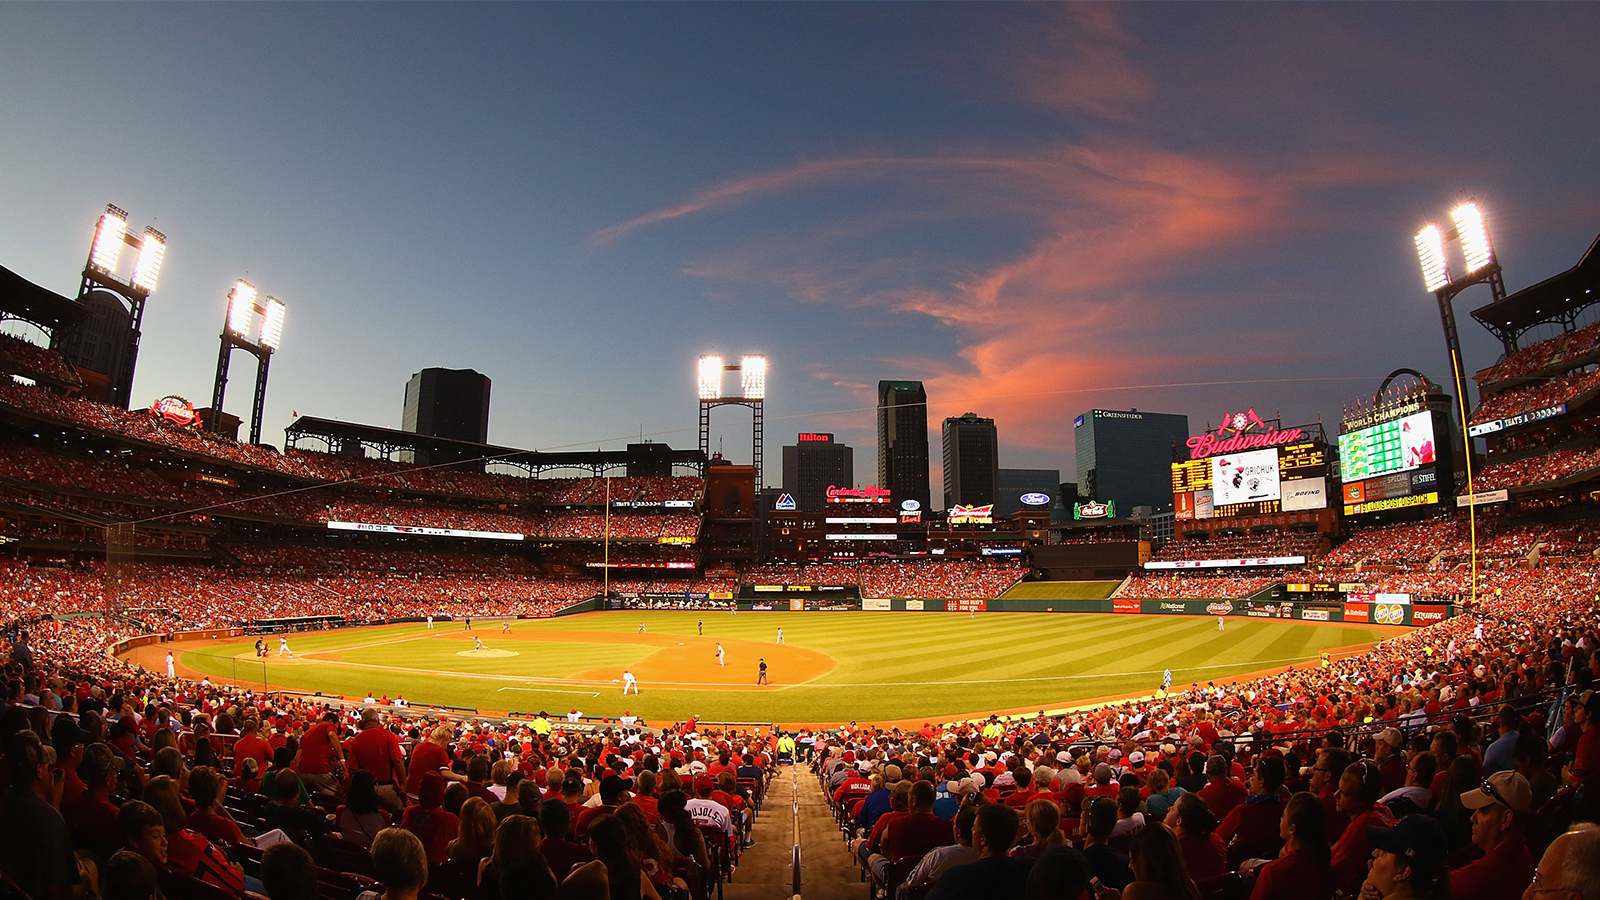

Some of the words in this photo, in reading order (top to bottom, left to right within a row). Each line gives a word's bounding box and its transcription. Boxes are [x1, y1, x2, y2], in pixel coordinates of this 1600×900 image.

[1103, 411, 1143, 420] GREENSFELDER
[1346, 417, 1373, 430] WORLD
[1373, 402, 1420, 422] CHAMPIONS
[799, 432, 829, 442] Hilton
[1186, 427, 1302, 459] Budweiser
[1245, 464, 1275, 477] GRICHUK
[826, 484, 861, 498] Cardinals
[860, 484, 891, 498] Nation
[1294, 489, 1321, 497] BOEING
[1413, 611, 1442, 621] EQUIFAX
[690, 805, 720, 820] UJOLS
